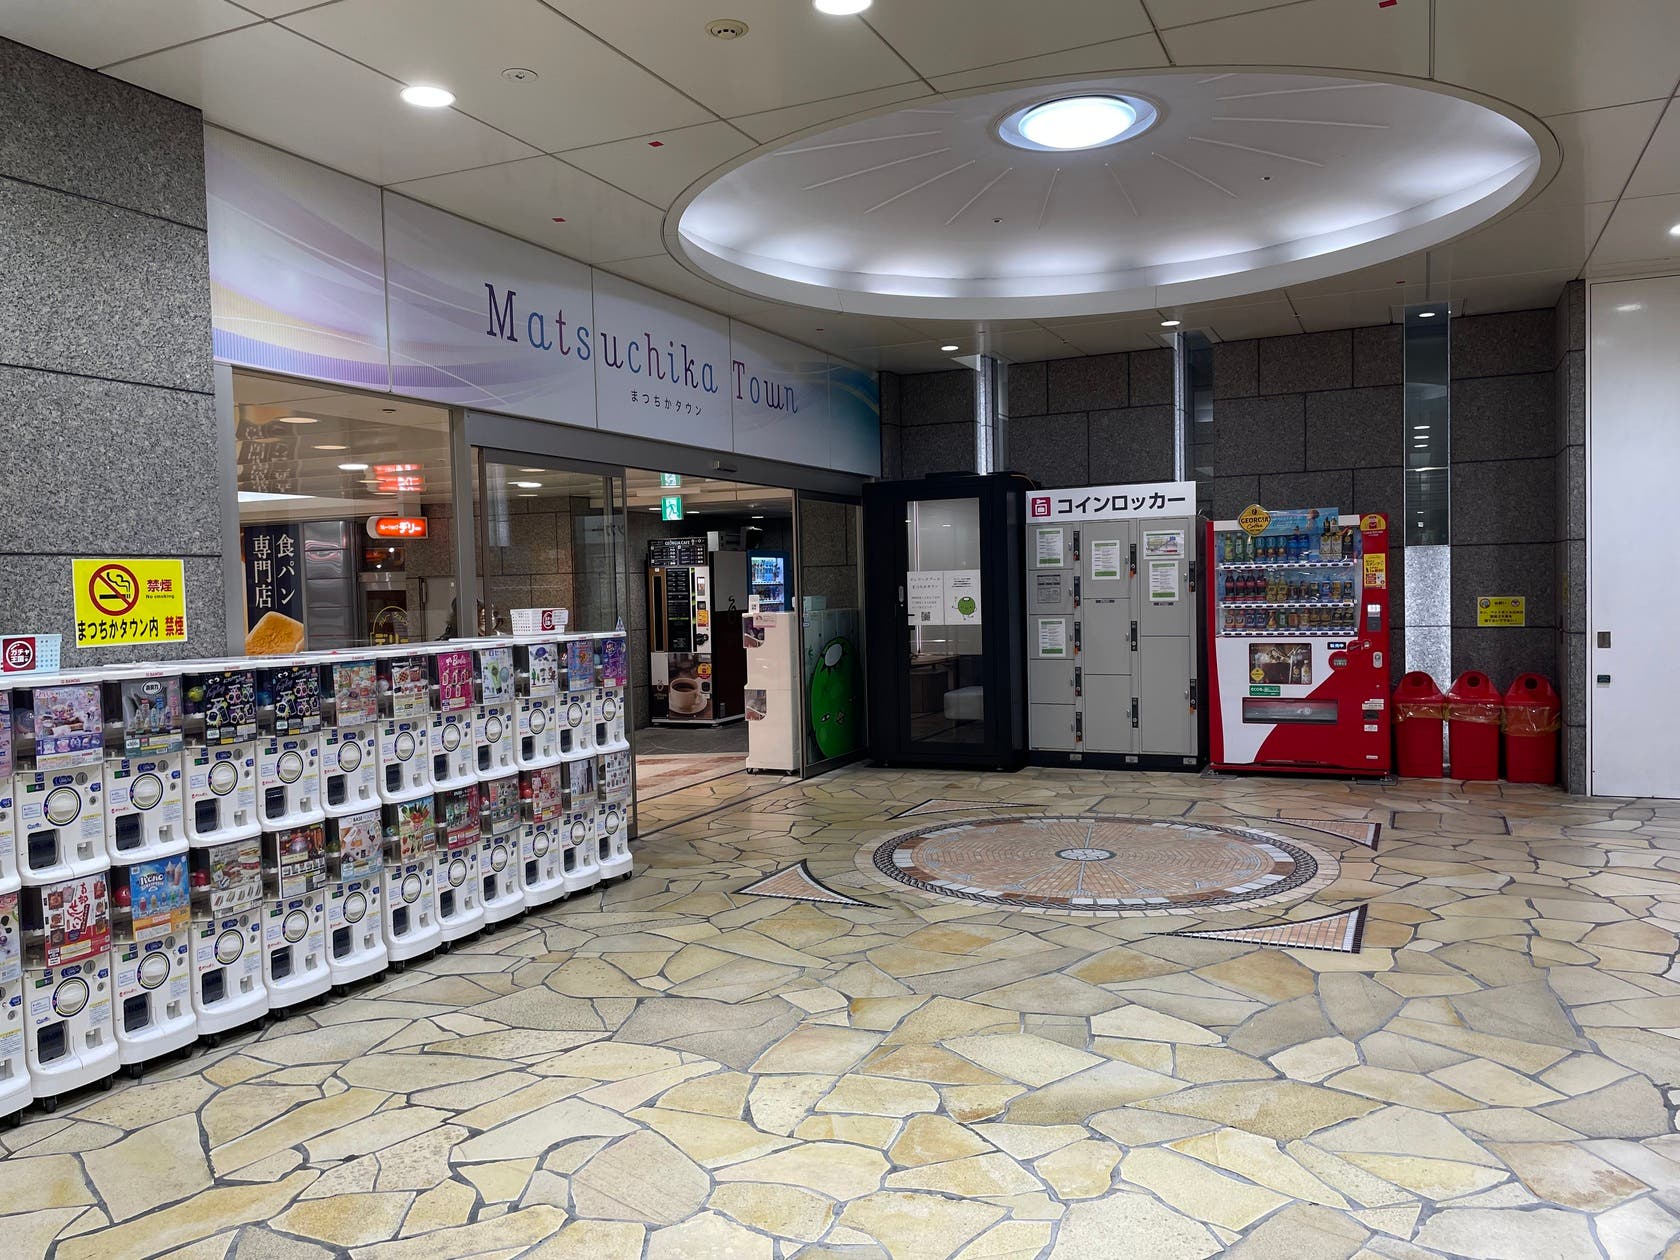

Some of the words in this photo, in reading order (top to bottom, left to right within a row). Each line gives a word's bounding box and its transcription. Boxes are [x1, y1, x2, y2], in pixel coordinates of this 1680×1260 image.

[484, 283, 718, 394] Matsuchika
[732, 359, 799, 414] Town
[630, 389, 704, 416] まつちかタウン
[1057, 492, 1186, 514] コインロッカー
[399, 521, 421, 534] デリー
[1240, 516, 1269, 524] GEORGIA
[252, 535, 273, 608] 専門店
[276, 534, 296, 606] 食パン
[146, 579, 172, 592] 禁煙
[155, 593, 175, 601] smoking
[77, 616, 159, 641] まつちかタウン内
[165, 616, 184, 637] 禁煙
[10, 647, 30, 656] ガチャ
[10, 655, 25, 663] 王国
